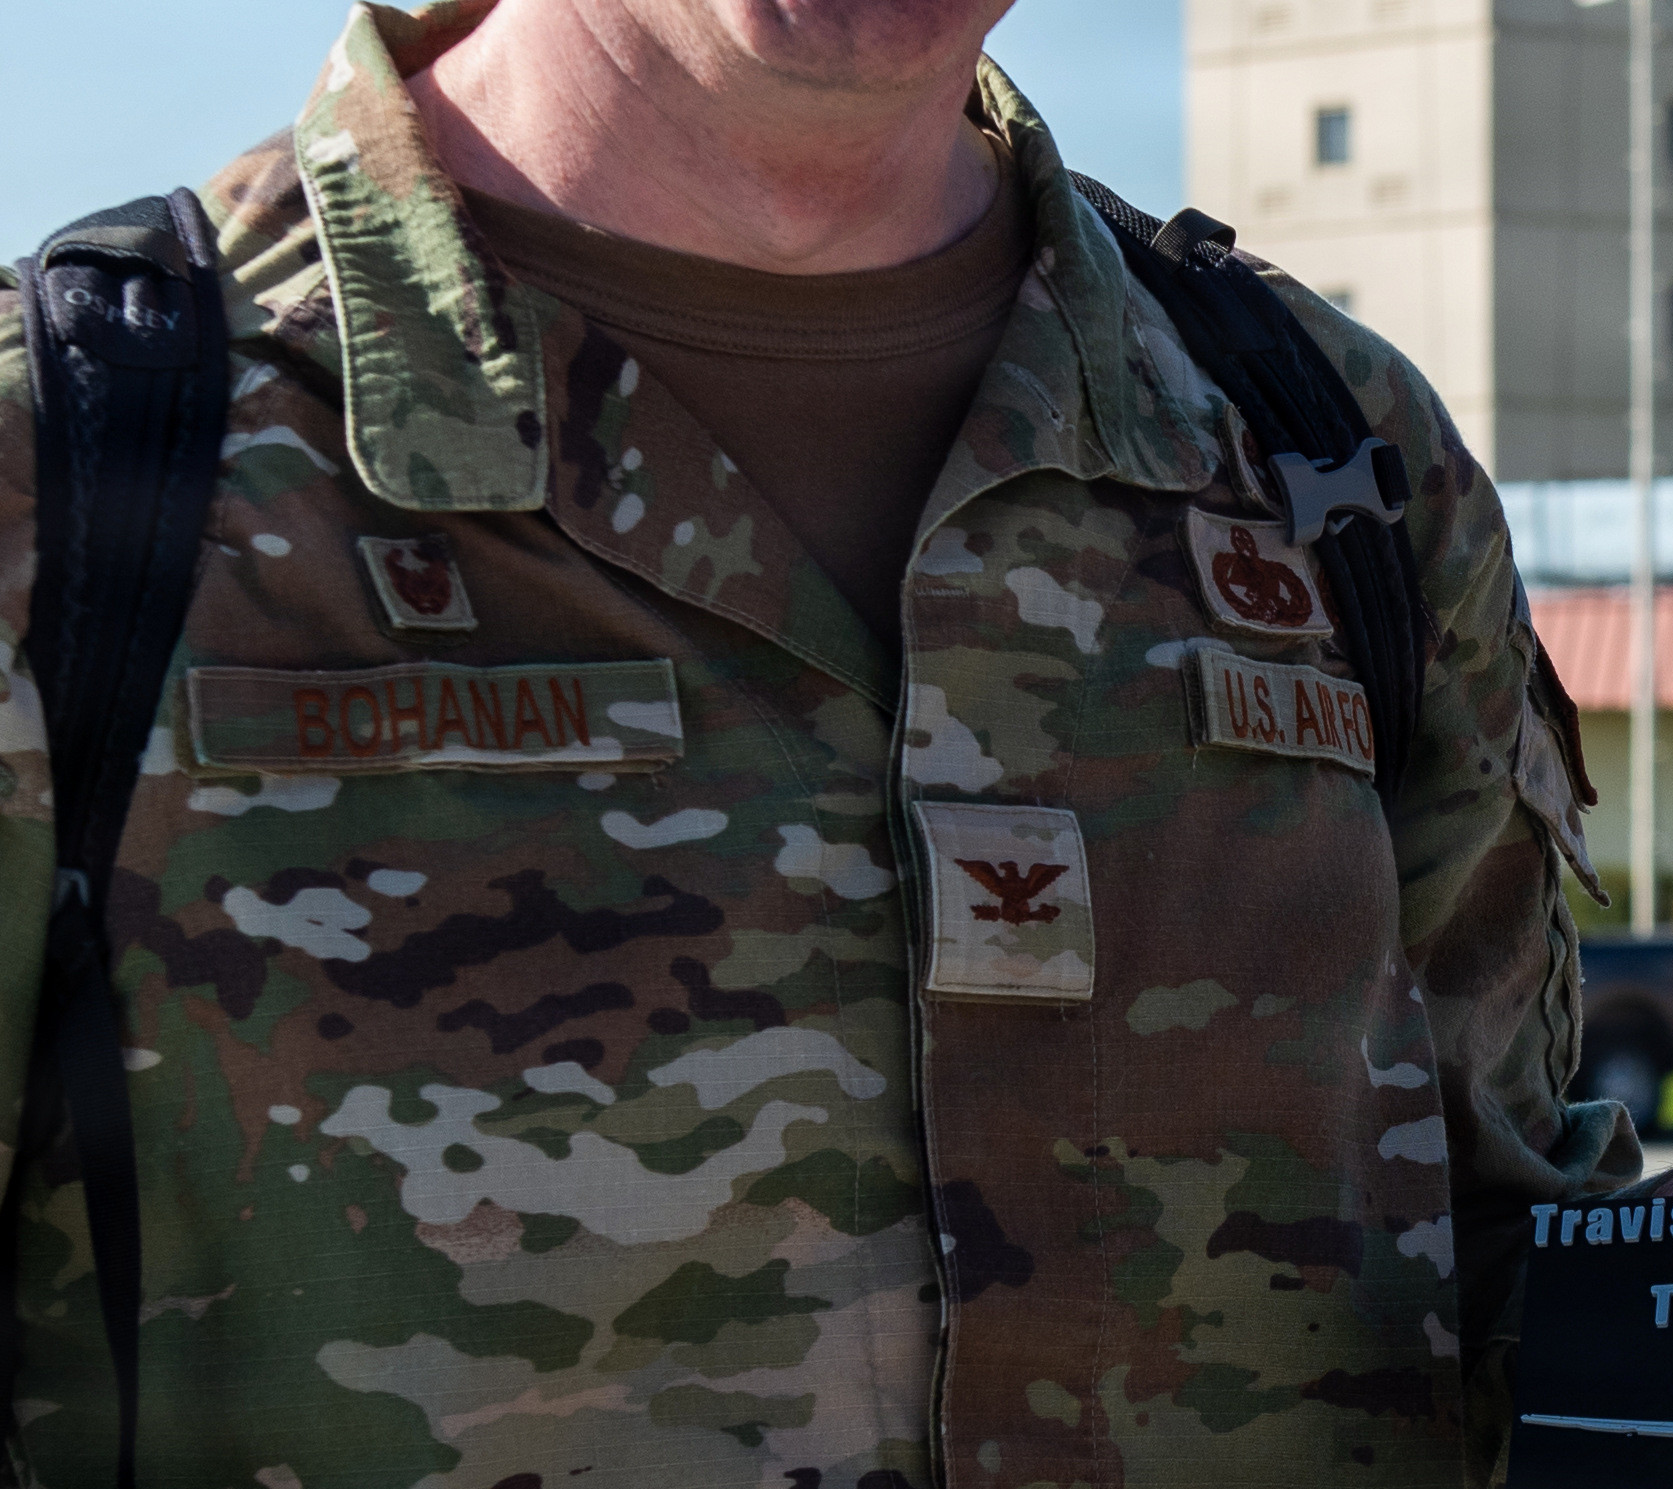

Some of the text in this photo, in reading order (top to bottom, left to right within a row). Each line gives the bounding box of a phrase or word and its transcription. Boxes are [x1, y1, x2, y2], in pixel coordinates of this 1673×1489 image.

[63, 288, 181, 331] OSPREY
[294, 677, 594, 759] BOHANAN
[1224, 669, 1286, 743] U.S.
[1295, 679, 1343, 750] AIR
